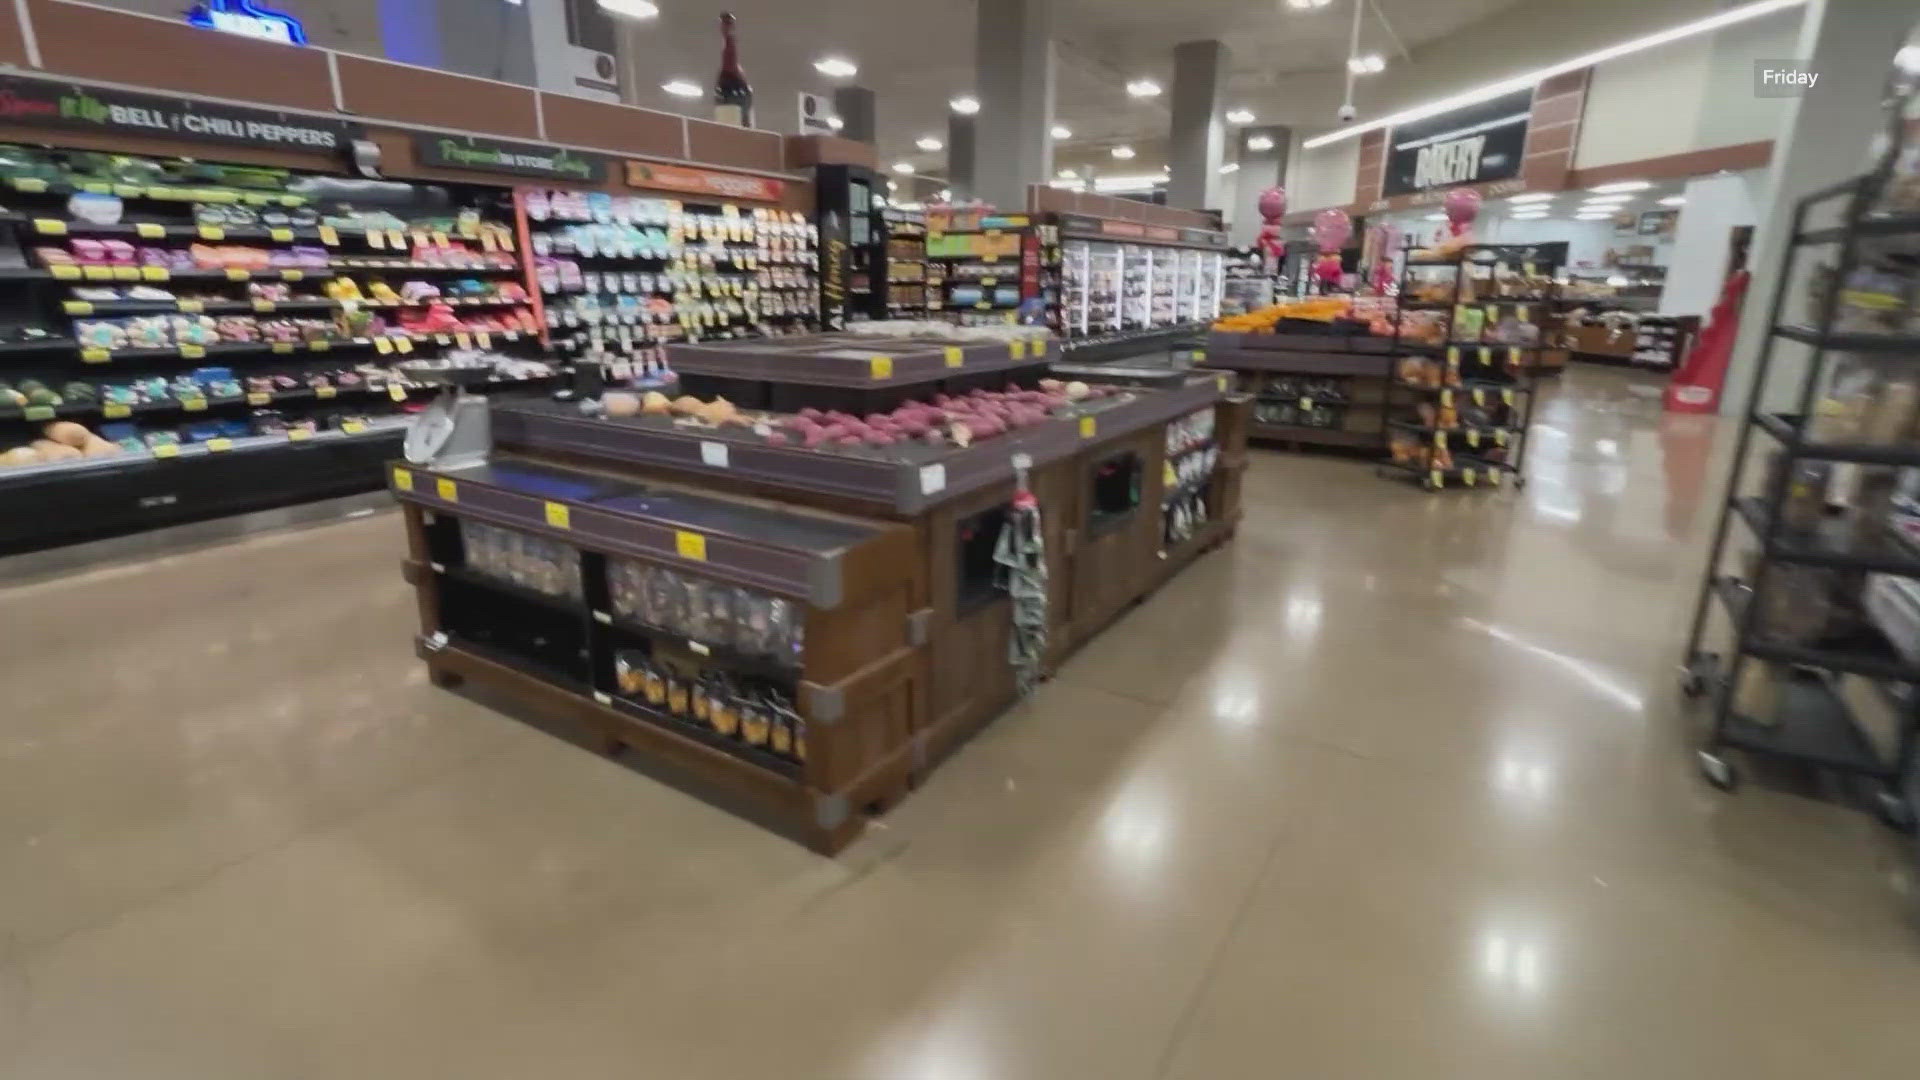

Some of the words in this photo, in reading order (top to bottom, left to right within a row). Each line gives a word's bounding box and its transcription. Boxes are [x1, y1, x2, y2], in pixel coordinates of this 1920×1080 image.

[109, 104, 169, 129] BELL
[183, 115, 244, 137] CHILI
[247, 121, 336, 147] PEPPERS
[1414, 135, 1486, 188] BAKERY
